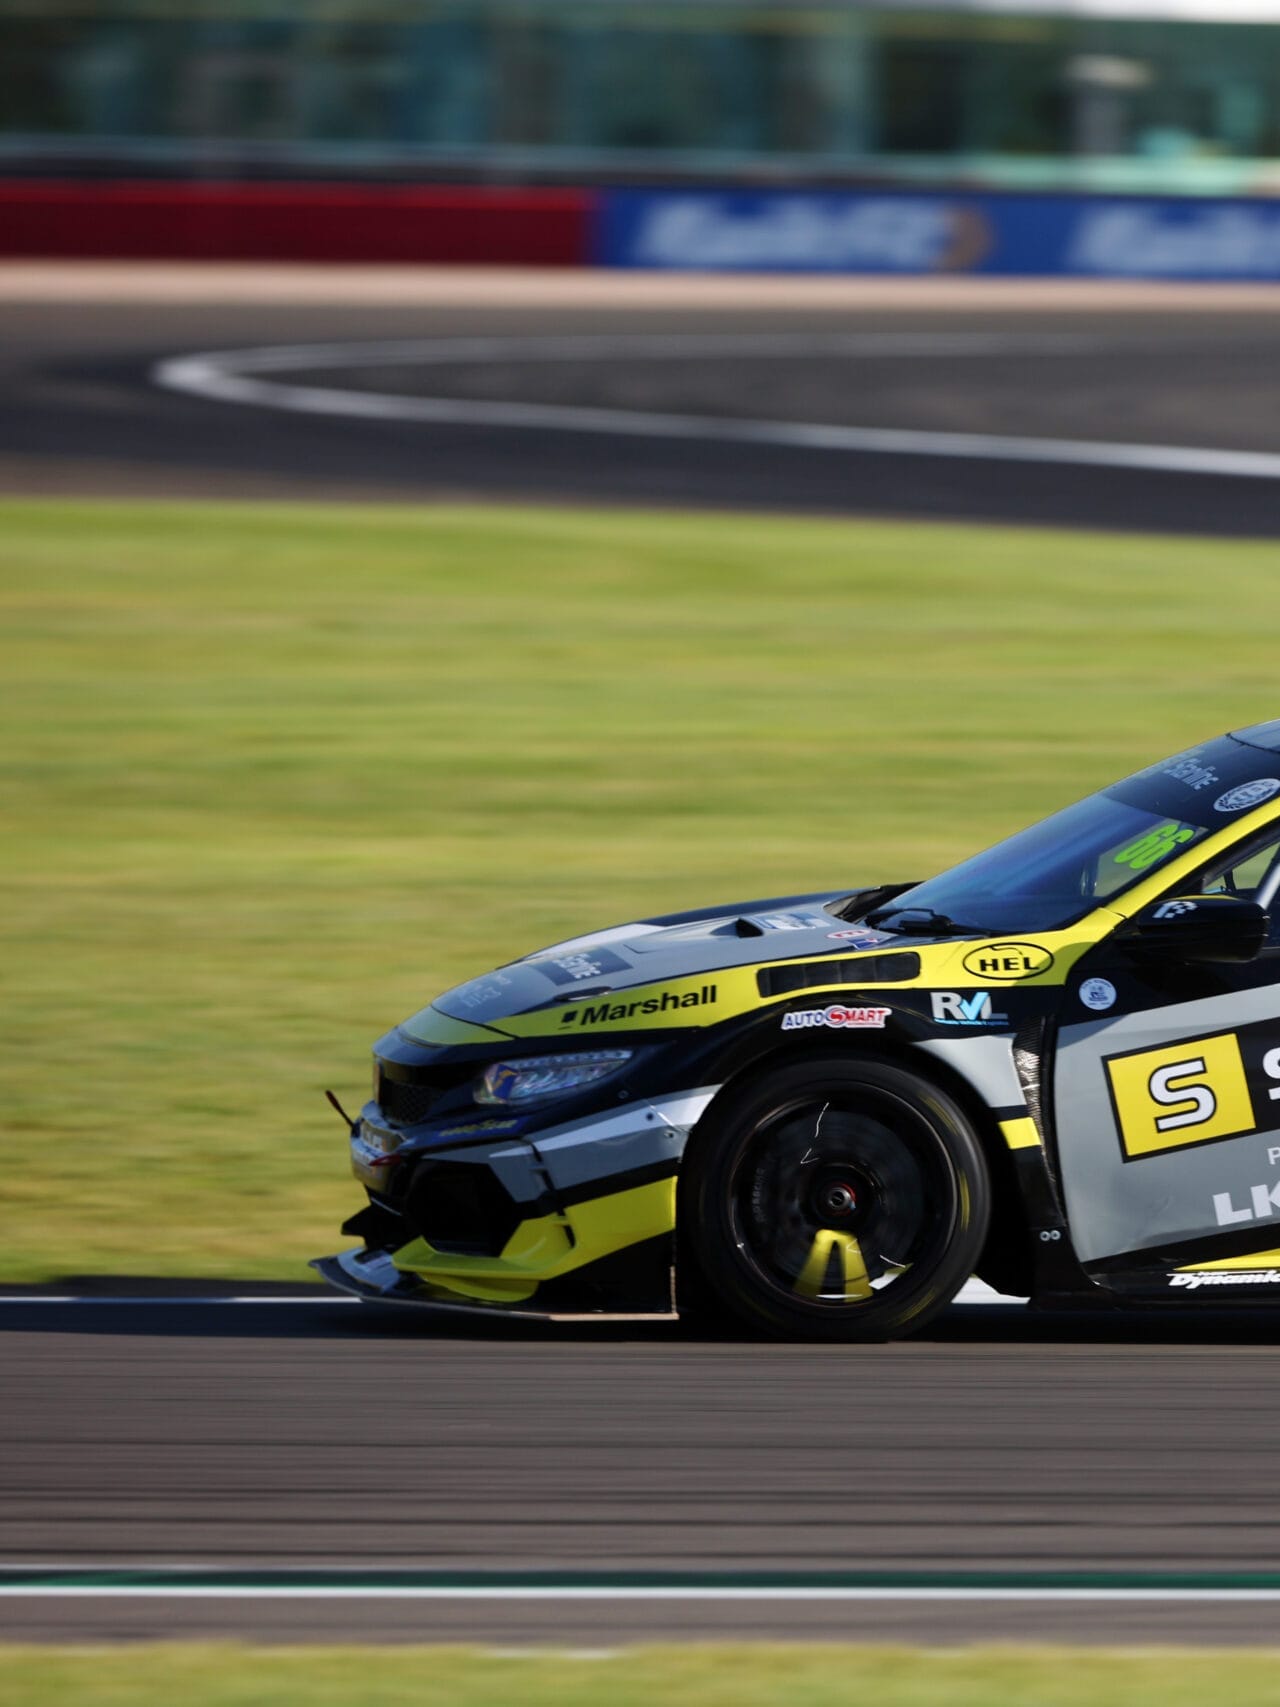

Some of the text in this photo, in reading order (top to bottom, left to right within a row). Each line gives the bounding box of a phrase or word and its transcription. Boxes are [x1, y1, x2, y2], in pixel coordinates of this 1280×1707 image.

[980, 957, 1040, 971] HEL
[580, 985, 717, 1026] Marshall
[1149, 1057, 1217, 1133] S
